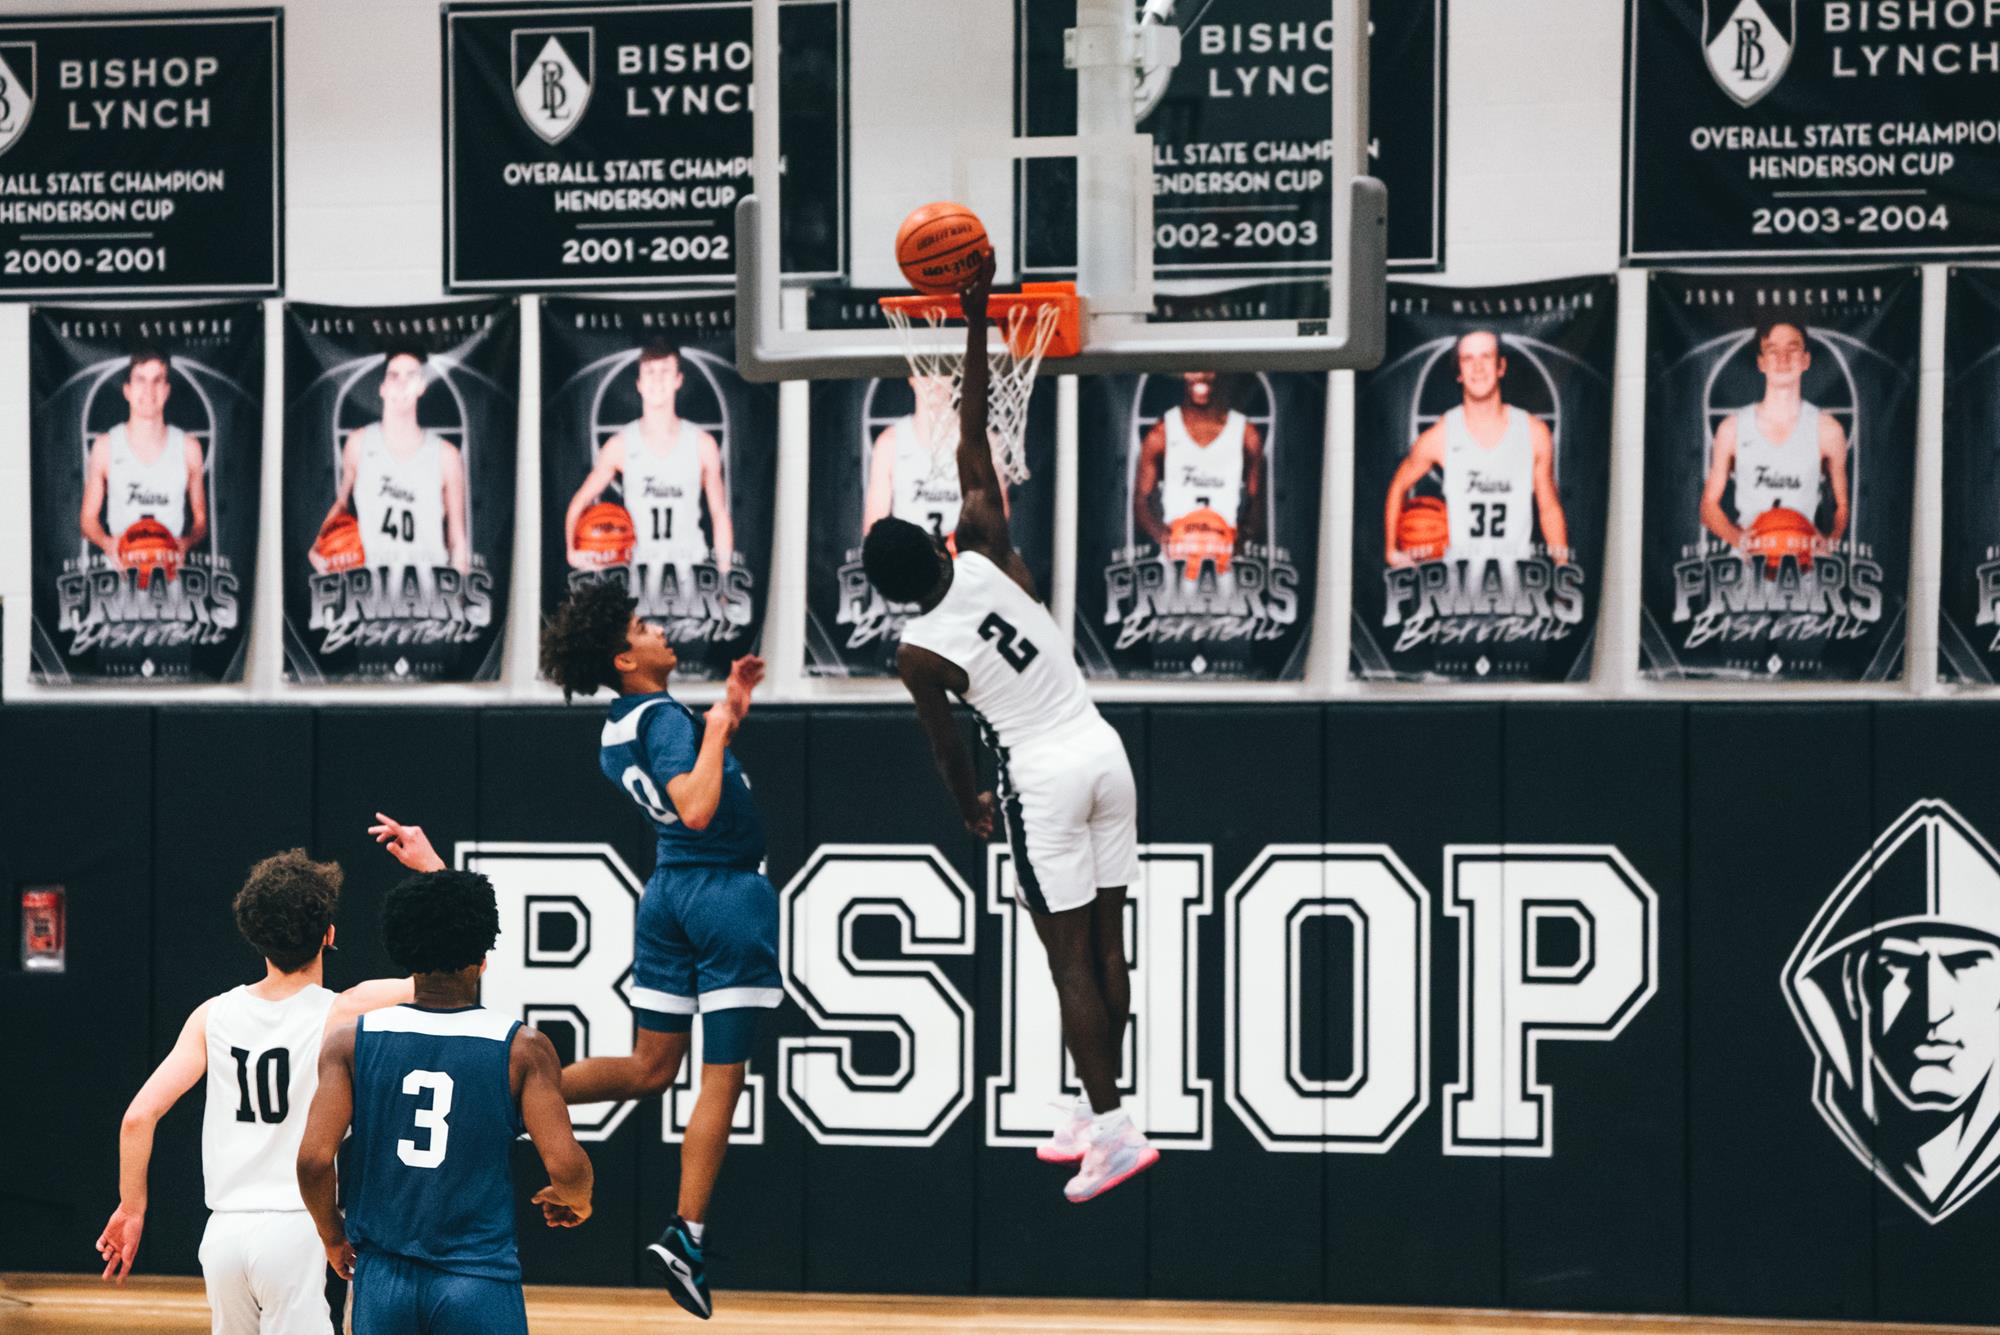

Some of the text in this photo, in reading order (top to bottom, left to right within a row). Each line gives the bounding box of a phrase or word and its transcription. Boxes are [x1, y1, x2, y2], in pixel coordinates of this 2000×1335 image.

[1201, 20, 1375, 55] BISHO
[60, 57, 218, 89] BISHOP
[617, 41, 752, 75] BISHO
[1832, 42, 1999, 77] LYNCH
[1209, 64, 1331, 98] LYNC
[68, 98, 211, 130] LYNCH
[1690, 120, 2000, 150] OVERALL STATE CHAMPIO
[1184, 142, 1247, 165] STATE
[1749, 152, 1954, 180] HENDERSON CUP
[46, 172, 105, 195] STATE
[110, 169, 224, 193] CHAMPION
[504, 161, 599, 185] OVERALL
[604, 159, 665, 182] STATE
[1153, 168, 1323, 195] ENDERSON CUP
[0, 200, 174, 223] HENDERSON CUP
[555, 185, 736, 212] HENDERSON CUP
[1156, 220, 1318, 249] 002-2003
[1752, 206, 1949, 234] 2003-2004
[4, 247, 166, 274] 2000-2001
[562, 234, 729, 264] 2001-2002
[381, 507, 415, 542] 40
[652, 507, 672, 539] 11
[1470, 503, 1507, 537] 32
[56, 566, 239, 632] FRIARS
[308, 566, 493, 630] FRIARS
[1104, 557, 1298, 626] FRIARS
[1383, 558, 1584, 628] FRIARS
[1672, 554, 1883, 624] FRIARS
[977, 611, 1039, 674] 2
[1393, 614, 1571, 652] BASKETBALL
[1683, 611, 1868, 649] BASKETBALL
[455, 842, 1659, 1158] BSHOP
[230, 1046, 289, 1124] 10
[397, 1069, 454, 1168] 3
